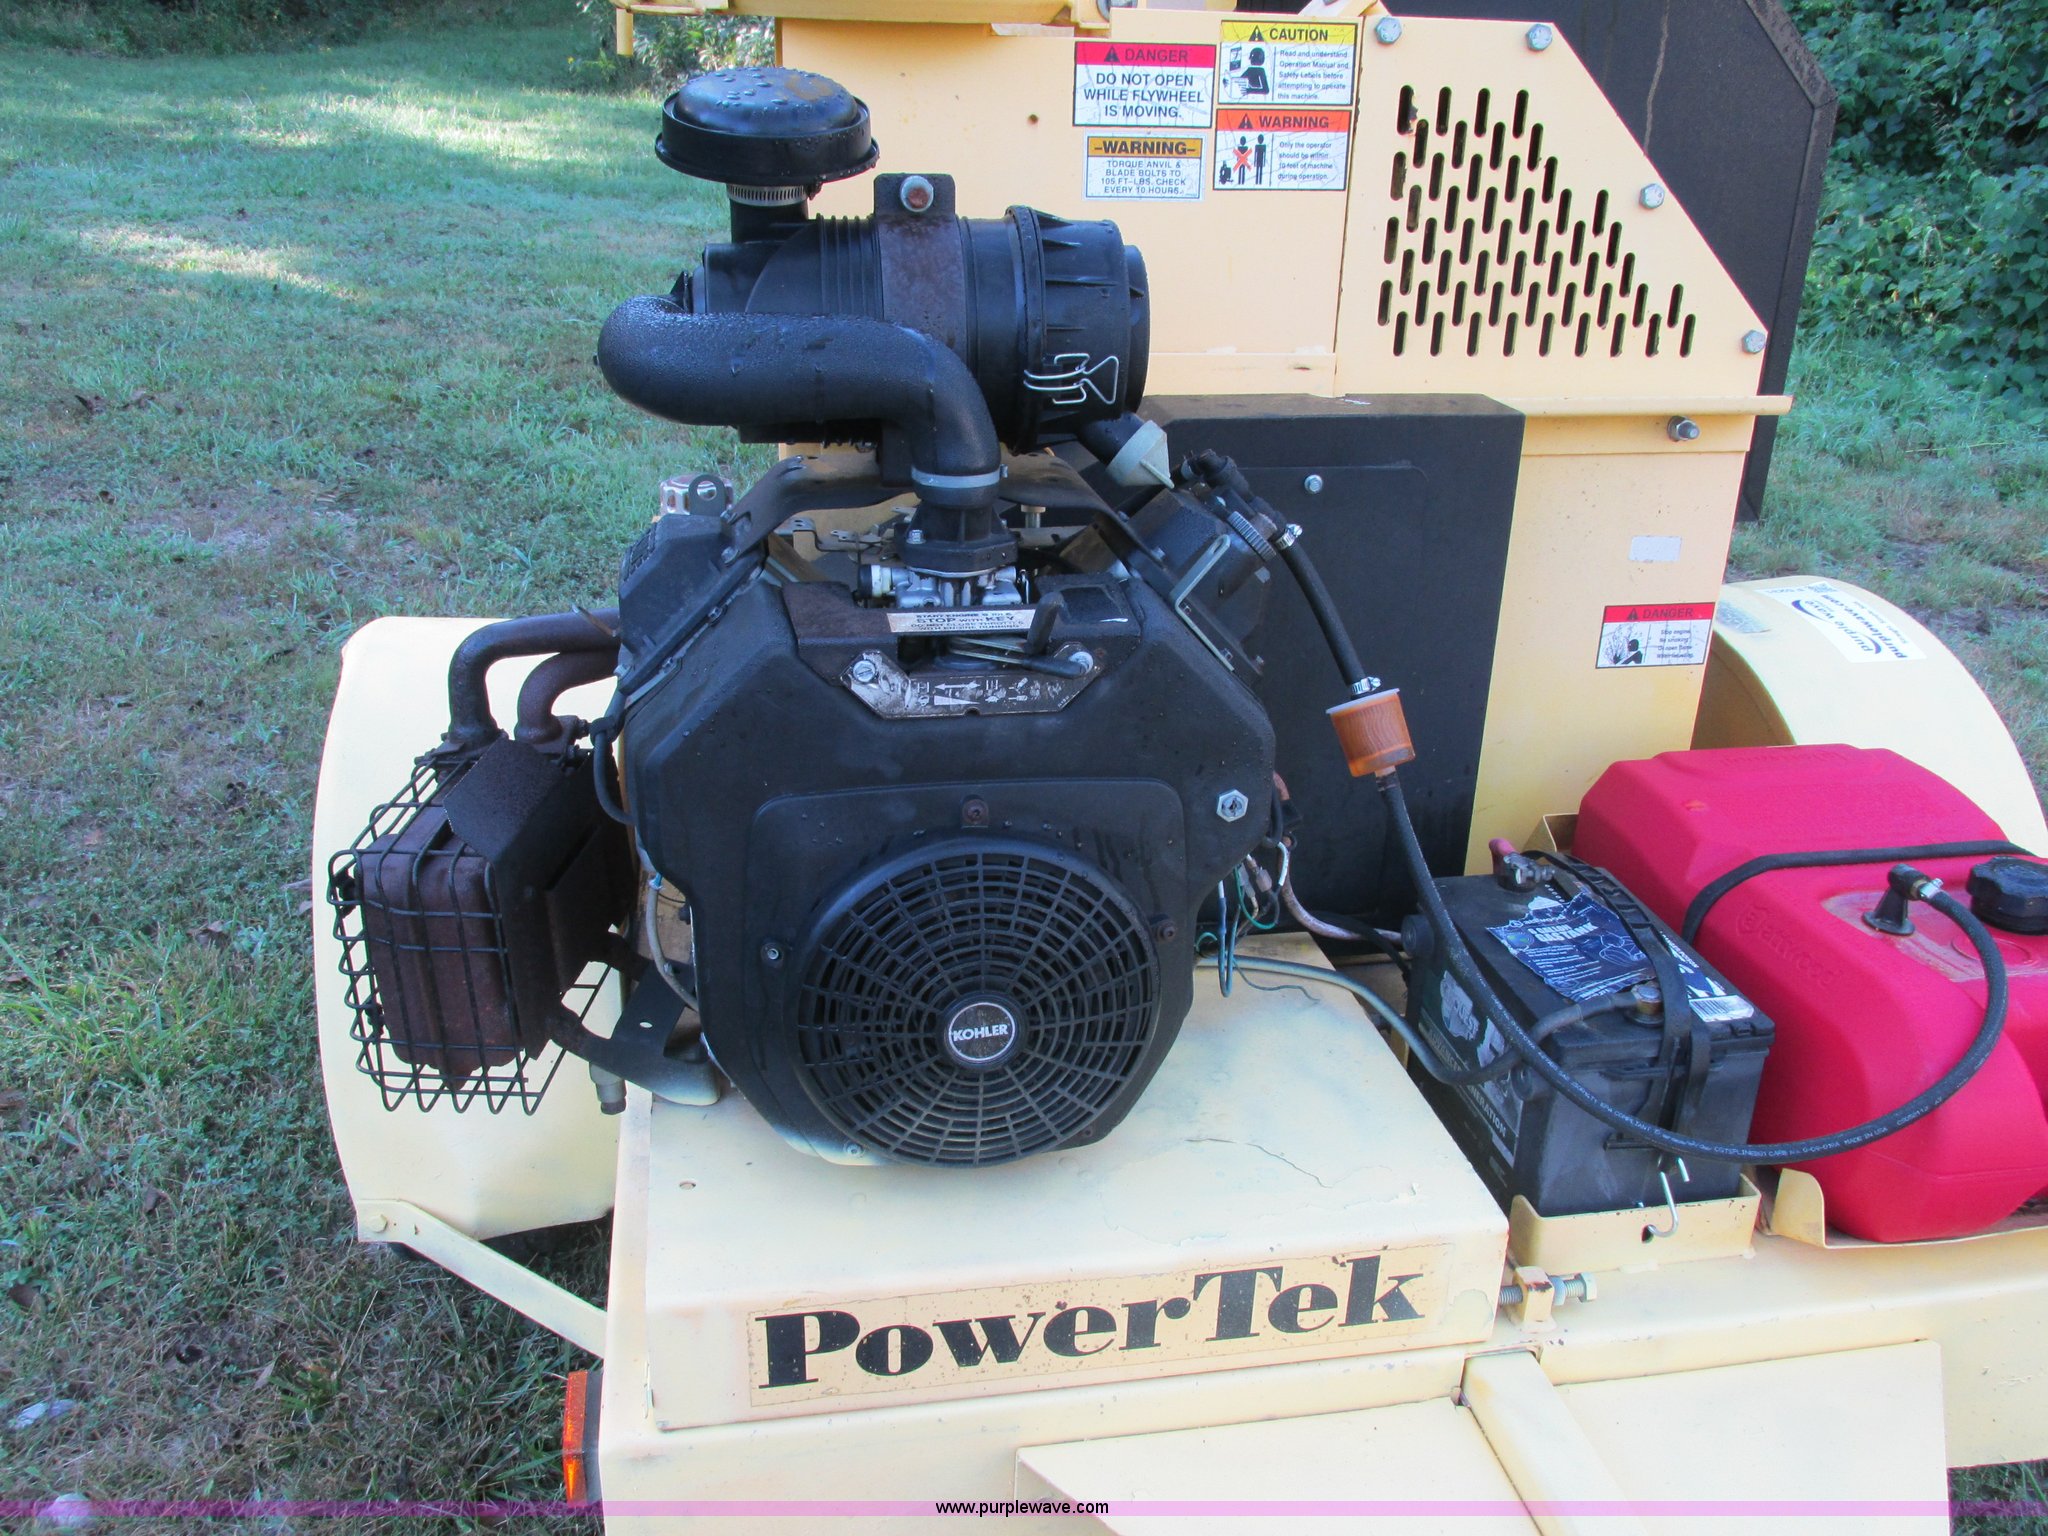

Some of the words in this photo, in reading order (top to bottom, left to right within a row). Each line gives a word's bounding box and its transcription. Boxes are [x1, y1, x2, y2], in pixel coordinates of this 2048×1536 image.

[1269, 27, 1329, 41] CAUTION
[1124, 48, 1189, 62] DANGER
[1096, 72, 1117, 85] DO
[1121, 73, 1151, 86] NOT
[1154, 74, 1194, 86] OPEN
[1321, 83, 1346, 91] operate
[1084, 88, 1128, 100] WHILE
[1132, 89, 1205, 102] FLYWHEEL
[1105, 104, 1118, 116] IS
[1122, 105, 1182, 118] MOVING.
[1259, 115, 1330, 128] WARNING
[1280, 141, 1294, 149] Only
[1306, 142, 1332, 150] operator
[1107, 160, 1144, 168] TORQUE
[1146, 160, 1172, 168] ANVIL
[1175, 161, 1181, 169] &
[1105, 169, 1135, 177] BLADE
[1138, 169, 1167, 177] BOLTS
[1170, 169, 1182, 178] TO
[1278, 172, 1298, 181] during
[1101, 177, 1116, 185] 105
[1155, 178, 1187, 186] CHECK
[1104, 186, 1133, 194] EVERY
[1642, 608, 1695, 620] DANGER
[952, 1023, 1009, 1042] KOHLER
[754, 1254, 1426, 1389] PowerTek
